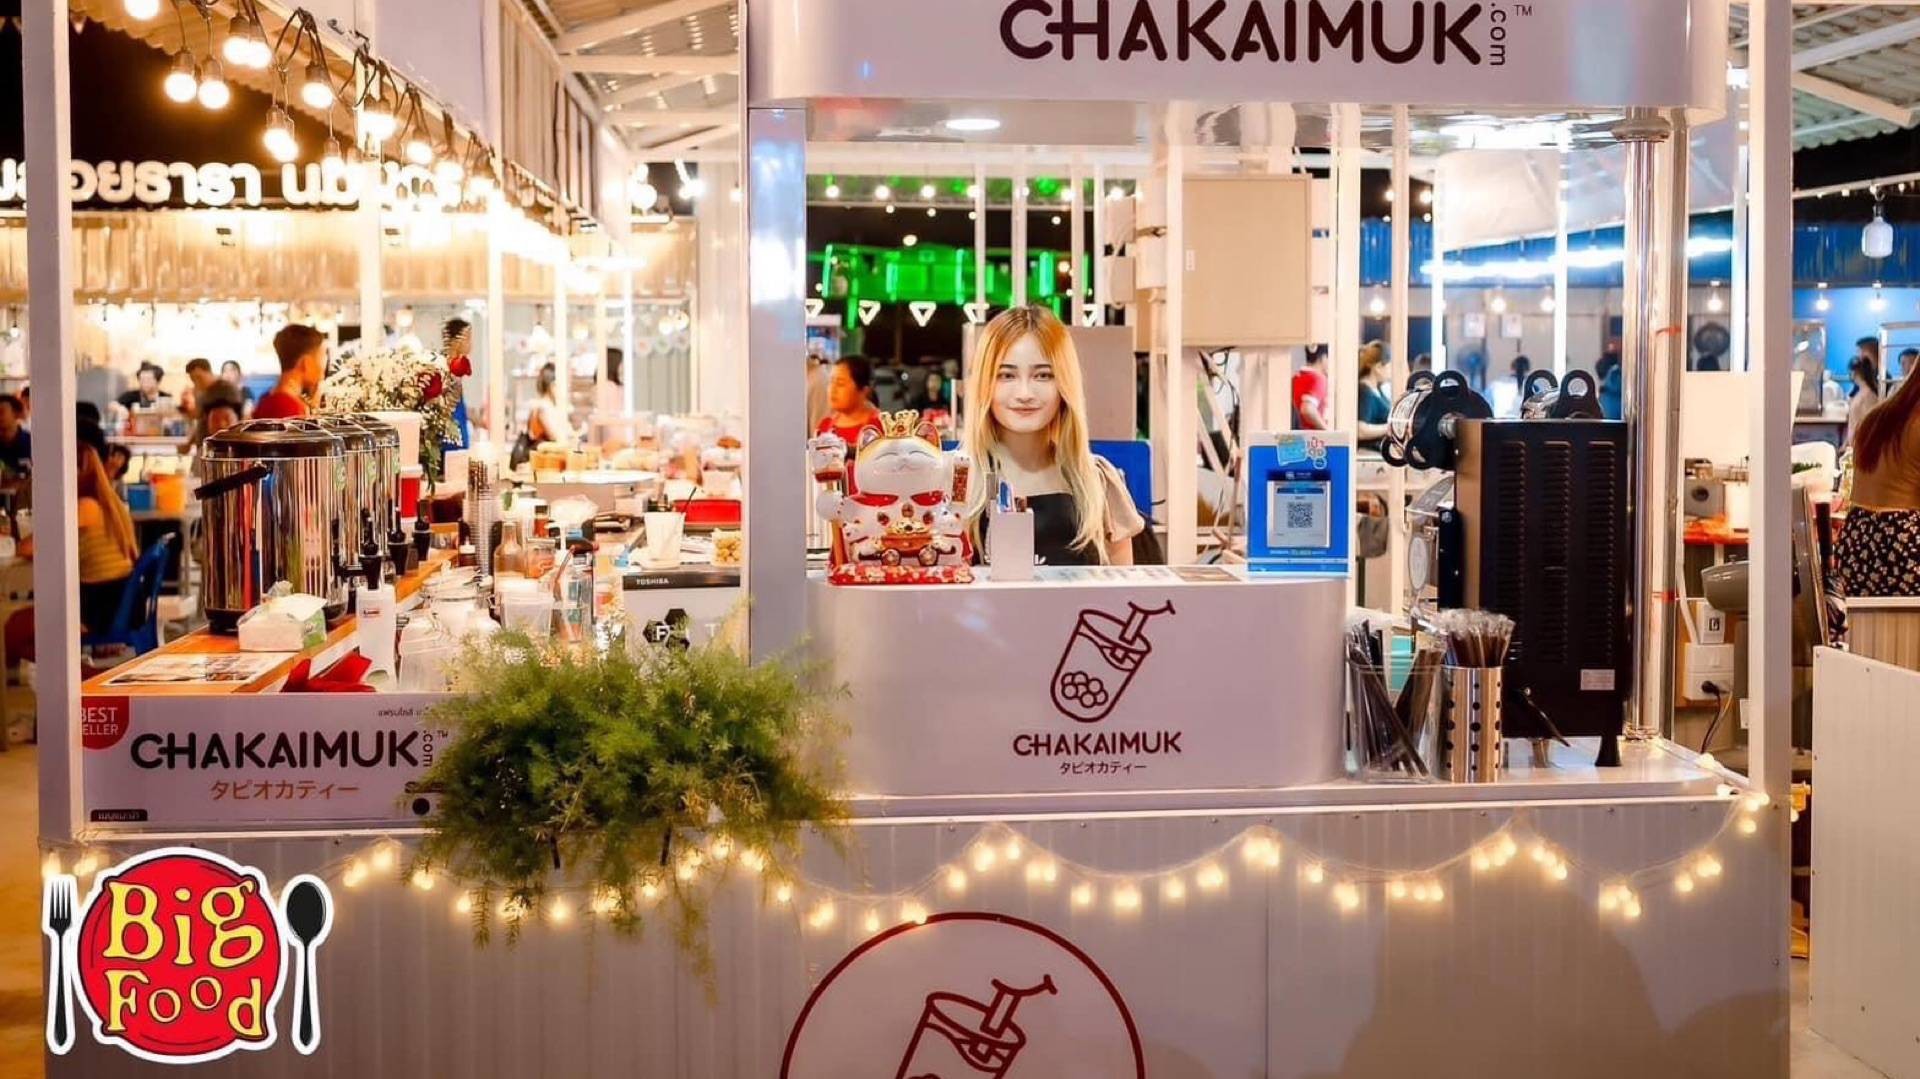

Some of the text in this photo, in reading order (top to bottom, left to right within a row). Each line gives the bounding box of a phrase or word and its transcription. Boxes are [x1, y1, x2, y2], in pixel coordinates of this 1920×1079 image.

[1000, 0, 1482, 65] CHAKAIMUK
[1490, 3, 1506, 66] .com
[636, 577, 669, 586] TOSHIBA
[82, 724, 118, 736] ELLER
[131, 730, 419, 769] CHAKAIMUK
[1013, 731, 1182, 756] CHAKAIMUK
